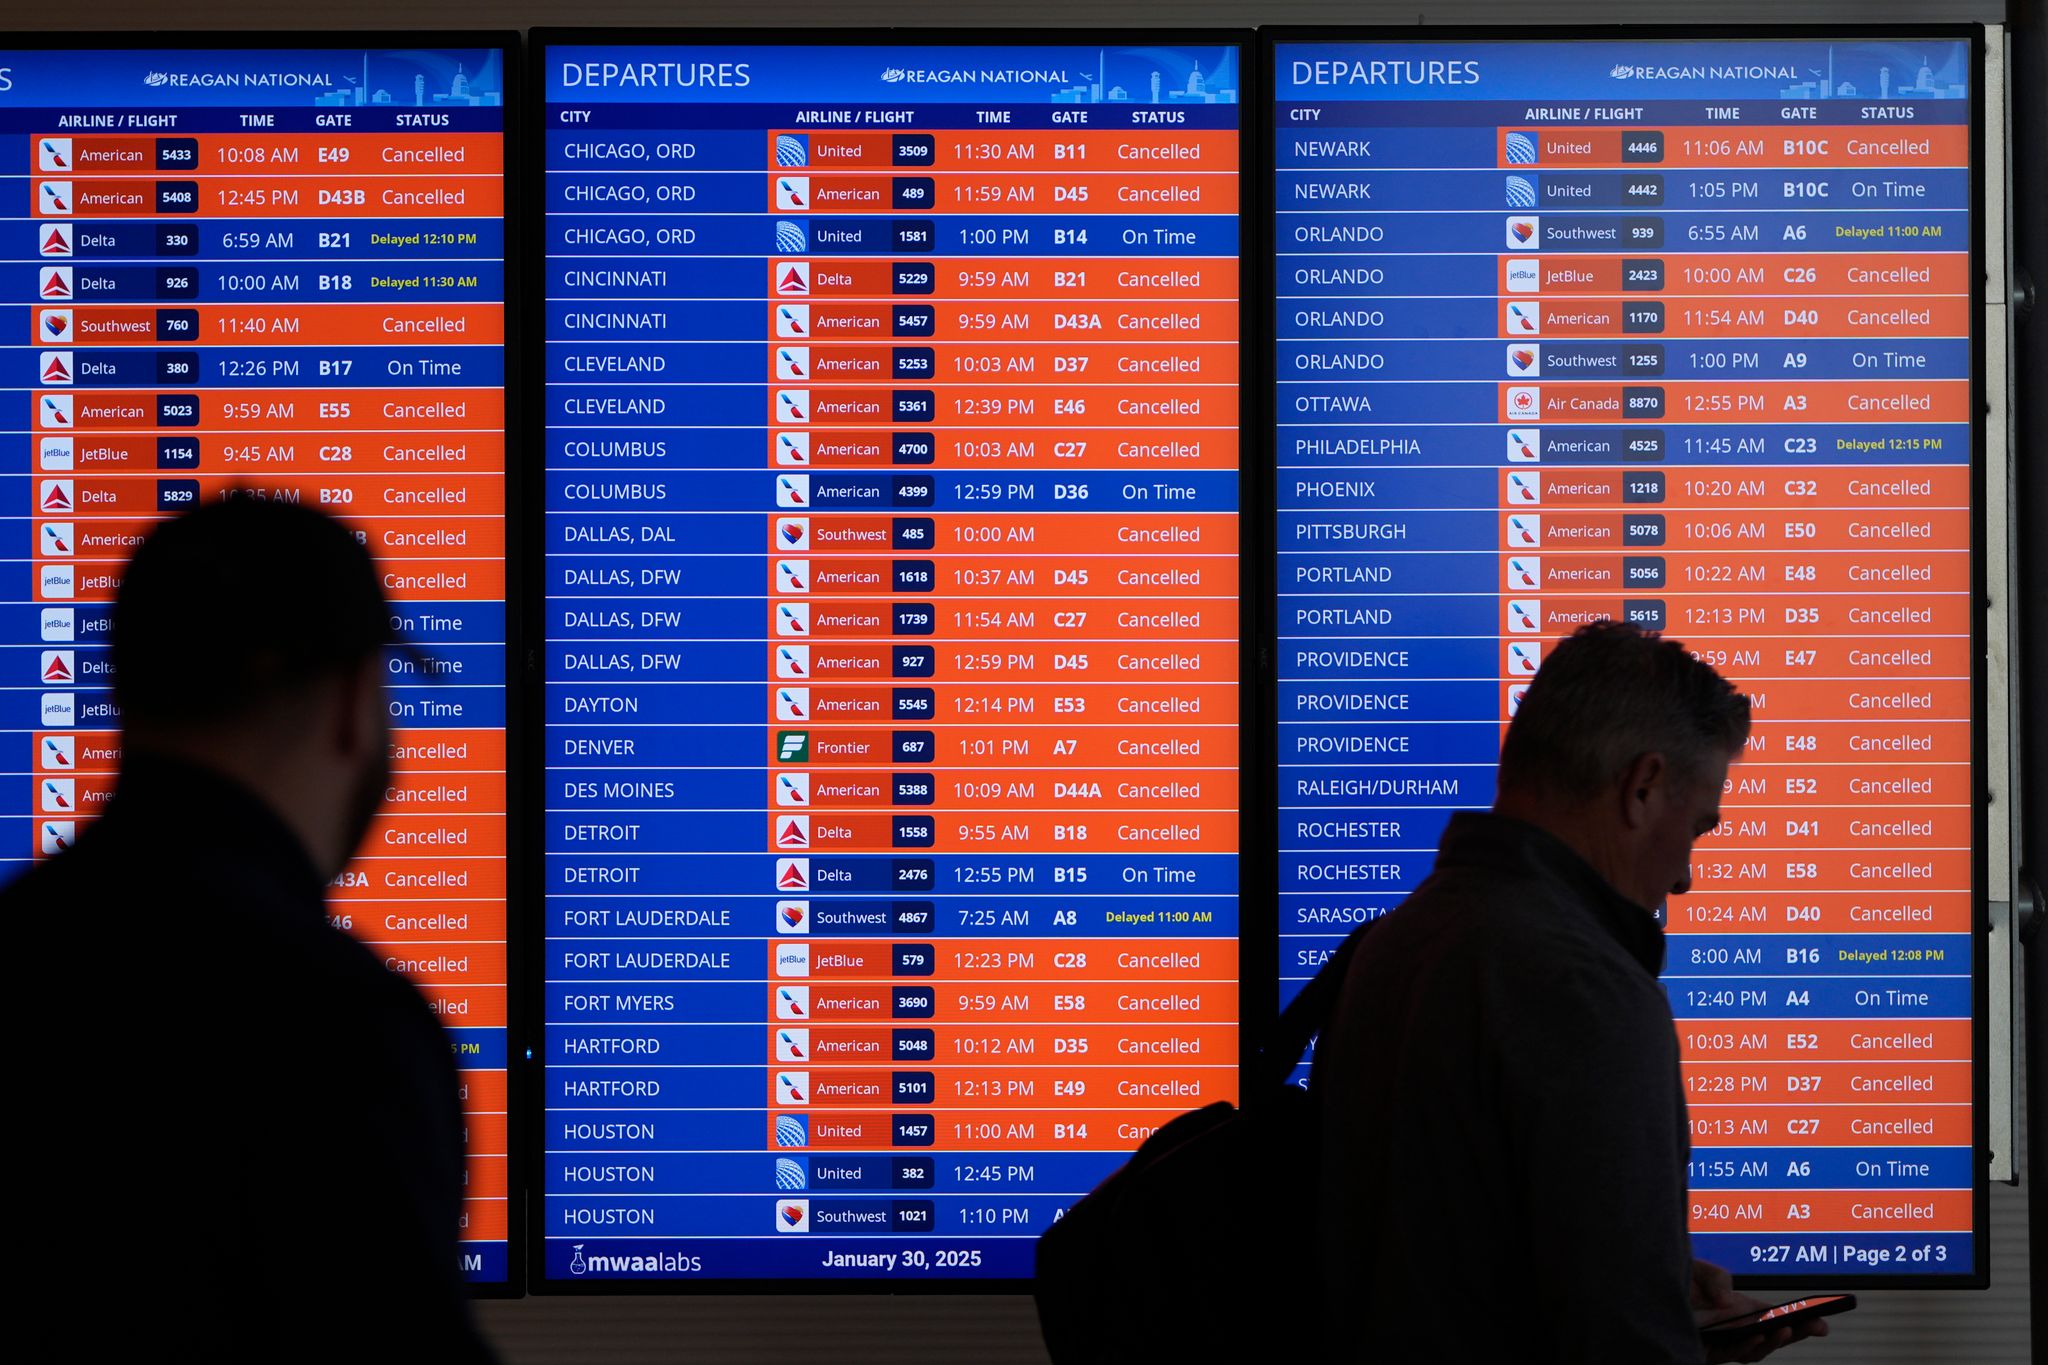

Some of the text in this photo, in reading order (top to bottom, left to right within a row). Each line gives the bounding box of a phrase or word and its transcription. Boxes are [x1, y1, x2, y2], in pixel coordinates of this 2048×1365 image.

[169, 73, 332, 87] REAGAN NATIONAL
[563, 63, 750, 87] DEPARTURES
[906, 70, 1068, 83] REAGAN NATIONAL
[1293, 60, 1480, 85] DEPARTURES
[1636, 66, 1798, 80] REAGAN NATIONAL
[58, 114, 115, 127] AIRLINE
[128, 114, 178, 127] FLIGHT
[239, 114, 275, 127] TIME
[315, 114, 352, 127] GATE
[396, 114, 450, 127] STATUS
[560, 110, 591, 123] CITY
[795, 110, 852, 123] AIRLINE
[865, 110, 915, 123] FLIGHT
[975, 111, 1011, 124] TIME
[1051, 111, 1088, 124] GATE
[1131, 111, 1186, 124] STATUS
[1290, 108, 1321, 121] CITY
[1524, 107, 1581, 120] AIRLINE
[1594, 107, 1644, 120] FLIGHT
[1705, 107, 1740, 120] TIME
[1780, 107, 1817, 120] GATE
[1861, 106, 1914, 119] STATUS
[79, 146, 465, 163] American 5433 10:08 AM E49 Cancelled
[564, 143, 1200, 161] CHICAGO, ORD United 3509 11:30 AM B11 Cancelled
[1295, 181, 1926, 199] NEWARK United 4442 1:05 PM B10C On Time
[81, 232, 477, 248] Delta 330 6:59 AM B21 Delayed 12:10 PM
[564, 313, 1200, 329] CINCINNATI American 5457 9:59 AM D43A Cancelled
[1295, 396, 1372, 412] OTTAWA
[1547, 397, 1567, 410] Air
[1570, 397, 1620, 410] Canada
[1629, 397, 1658, 409] 8870
[1684, 395, 1732, 411] 12:55
[1738, 395, 1764, 411] PM
[1783, 395, 1807, 411] A3
[1847, 394, 1930, 411] Cancelled
[44, 444, 466, 463] jetBlue JetBlue 1154 9:45 AM C28 Cancelled
[565, 526, 1200, 545] DALLAS, DAL Southwest 485 10:00 AM Cancelled
[1296, 564, 1931, 583] PORTLAND American 5056 10:22 AM E48 Cancelled
[565, 739, 1200, 755] DENVER Frontier 687 1:01 PM A7 Cancelled
[1297, 779, 1458, 796] RALEIGH/DURHAM
[1737, 778, 1766, 794] AM
[1786, 778, 1817, 794] E52
[1849, 777, 1932, 794] Cancelled
[326, 870, 468, 887] 43A Cancelled
[564, 910, 1212, 926] FORT LAUDERDALE Southwest 4867 7:25 AM A8 Delayed 11:00 AM
[384, 956, 468, 972] Cancelled
[1691, 948, 1944, 964] 8:00 AM B16 Delayed 12:08 PM
[564, 1165, 1034, 1182] HOUSTON United 382 12:45 PM
[1692, 1202, 1934, 1220] 9:40 AM A3 Cancelled
[587, 1251, 702, 1272] mwaalabs
[821, 1250, 982, 1272] January 30, 2025
[1750, 1245, 1791, 1263] 9:27
[1795, 1245, 1827, 1262] AM
[1843, 1245, 1891, 1267] Page
[1895, 1245, 1907, 1262] 2
[1911, 1244, 1931, 1262] of
[1935, 1245, 1947, 1262] 3
